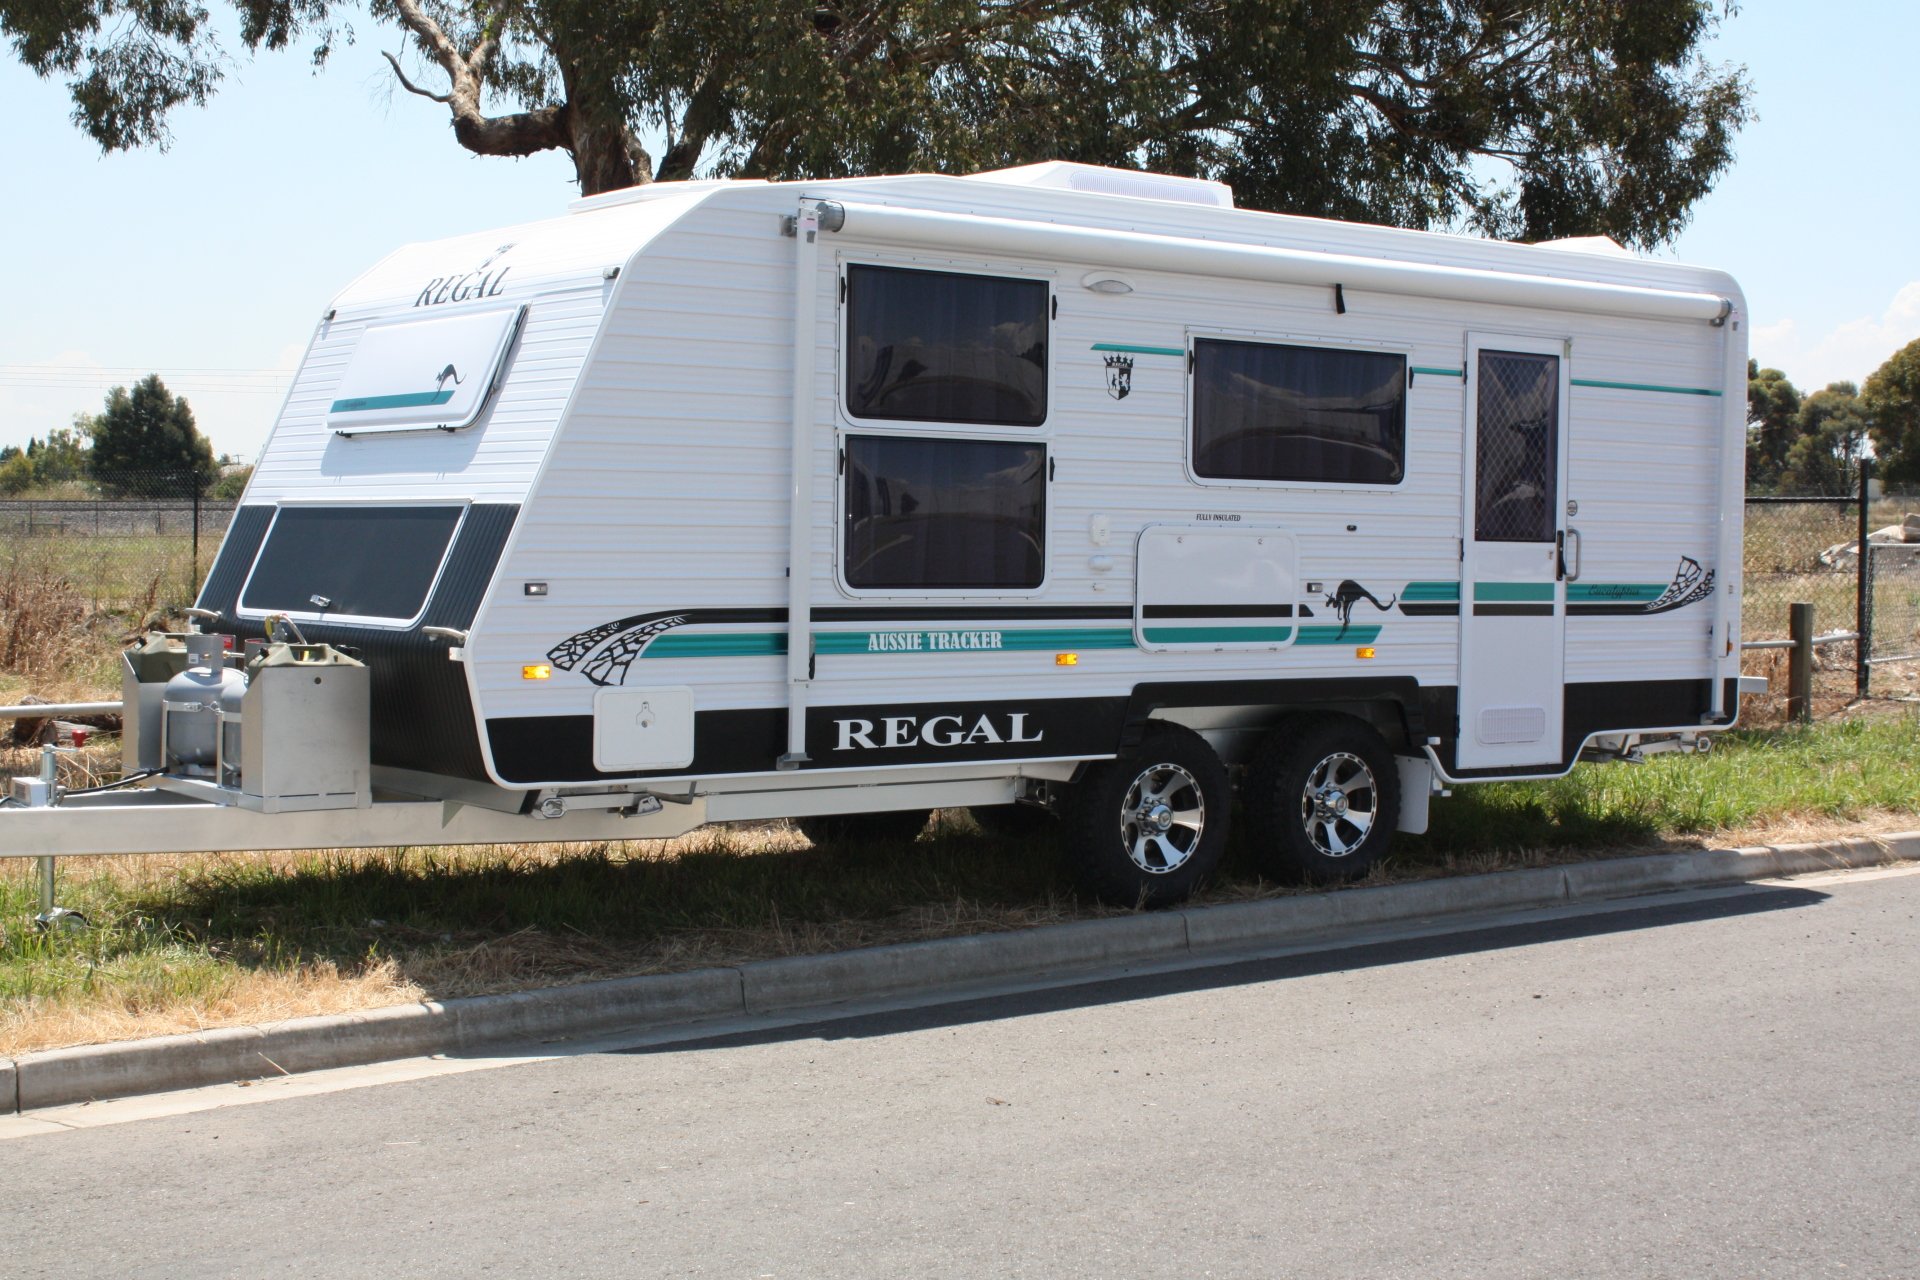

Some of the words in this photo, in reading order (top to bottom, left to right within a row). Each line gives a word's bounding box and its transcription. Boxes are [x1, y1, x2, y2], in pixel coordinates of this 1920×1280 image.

[412, 266, 511, 307] REGAL
[1196, 513, 1212, 521] FULLY
[1213, 514, 1241, 522] INSULATED
[868, 632, 923, 651] AUSSIE
[927, 631, 1002, 650] TRACKER
[832, 713, 1043, 750] REGAL
